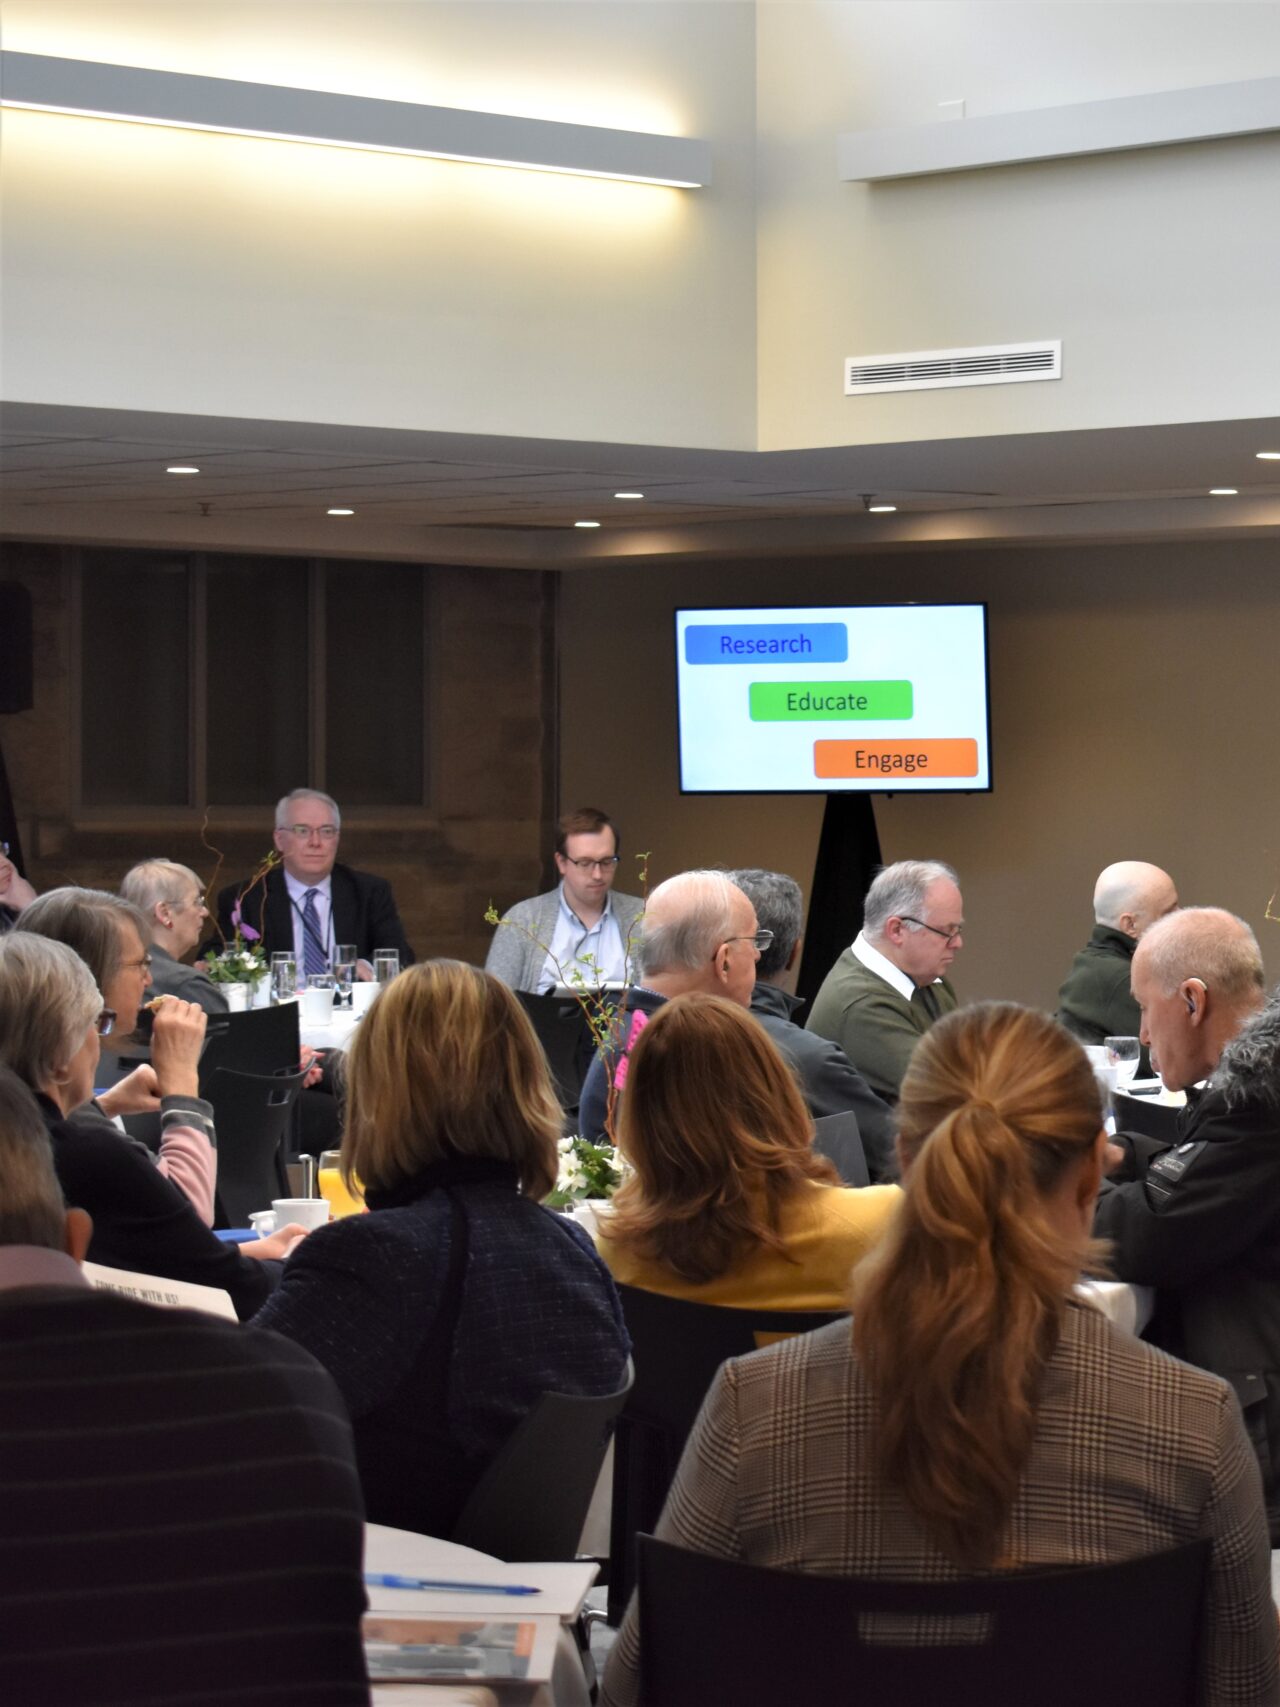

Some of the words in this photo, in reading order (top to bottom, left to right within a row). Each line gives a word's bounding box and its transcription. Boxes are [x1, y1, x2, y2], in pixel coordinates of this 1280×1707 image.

[720, 634, 812, 654] Research
[787, 691, 868, 711] Educate
[855, 750, 928, 772] Engage
